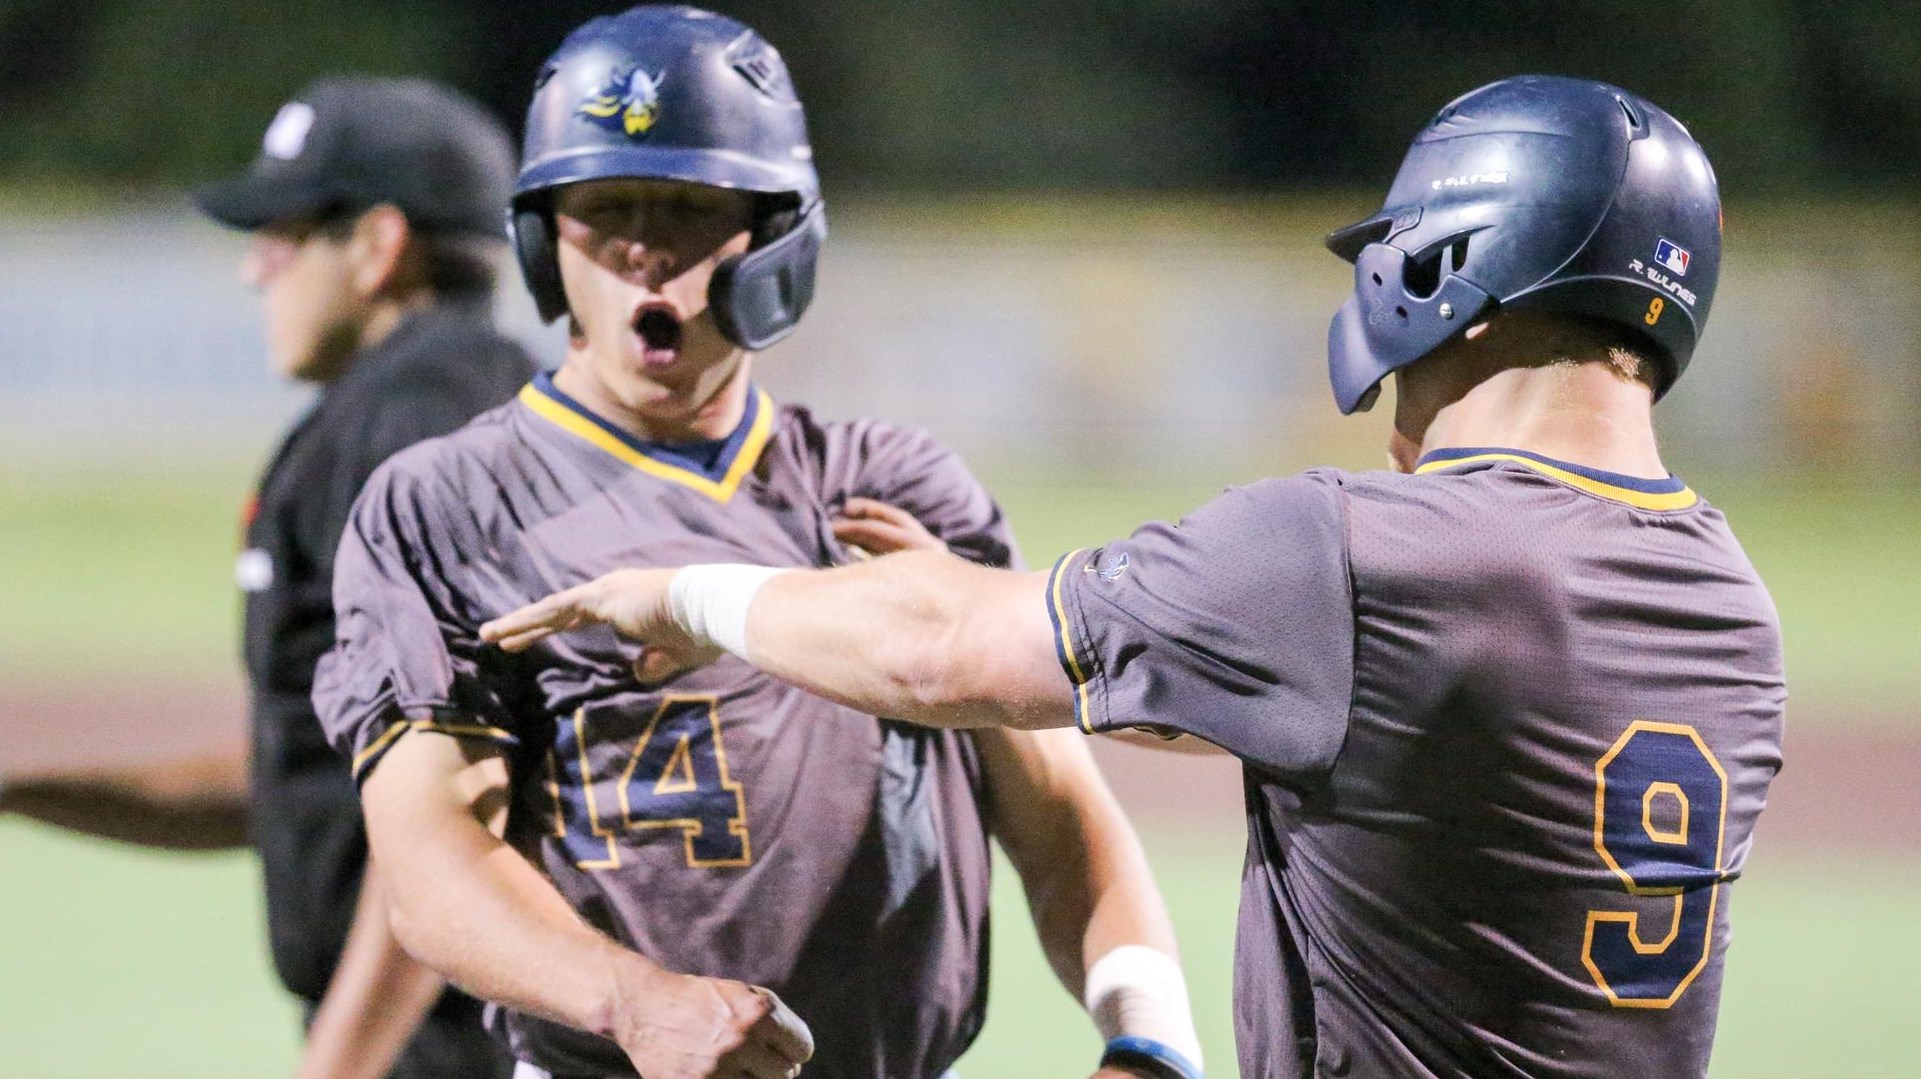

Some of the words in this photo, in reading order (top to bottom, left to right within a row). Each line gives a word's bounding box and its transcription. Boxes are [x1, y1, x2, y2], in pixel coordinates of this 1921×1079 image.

[1645, 297, 1664, 325] 9
[549, 693, 751, 870] 14
[1581, 720, 1727, 1009] 9
